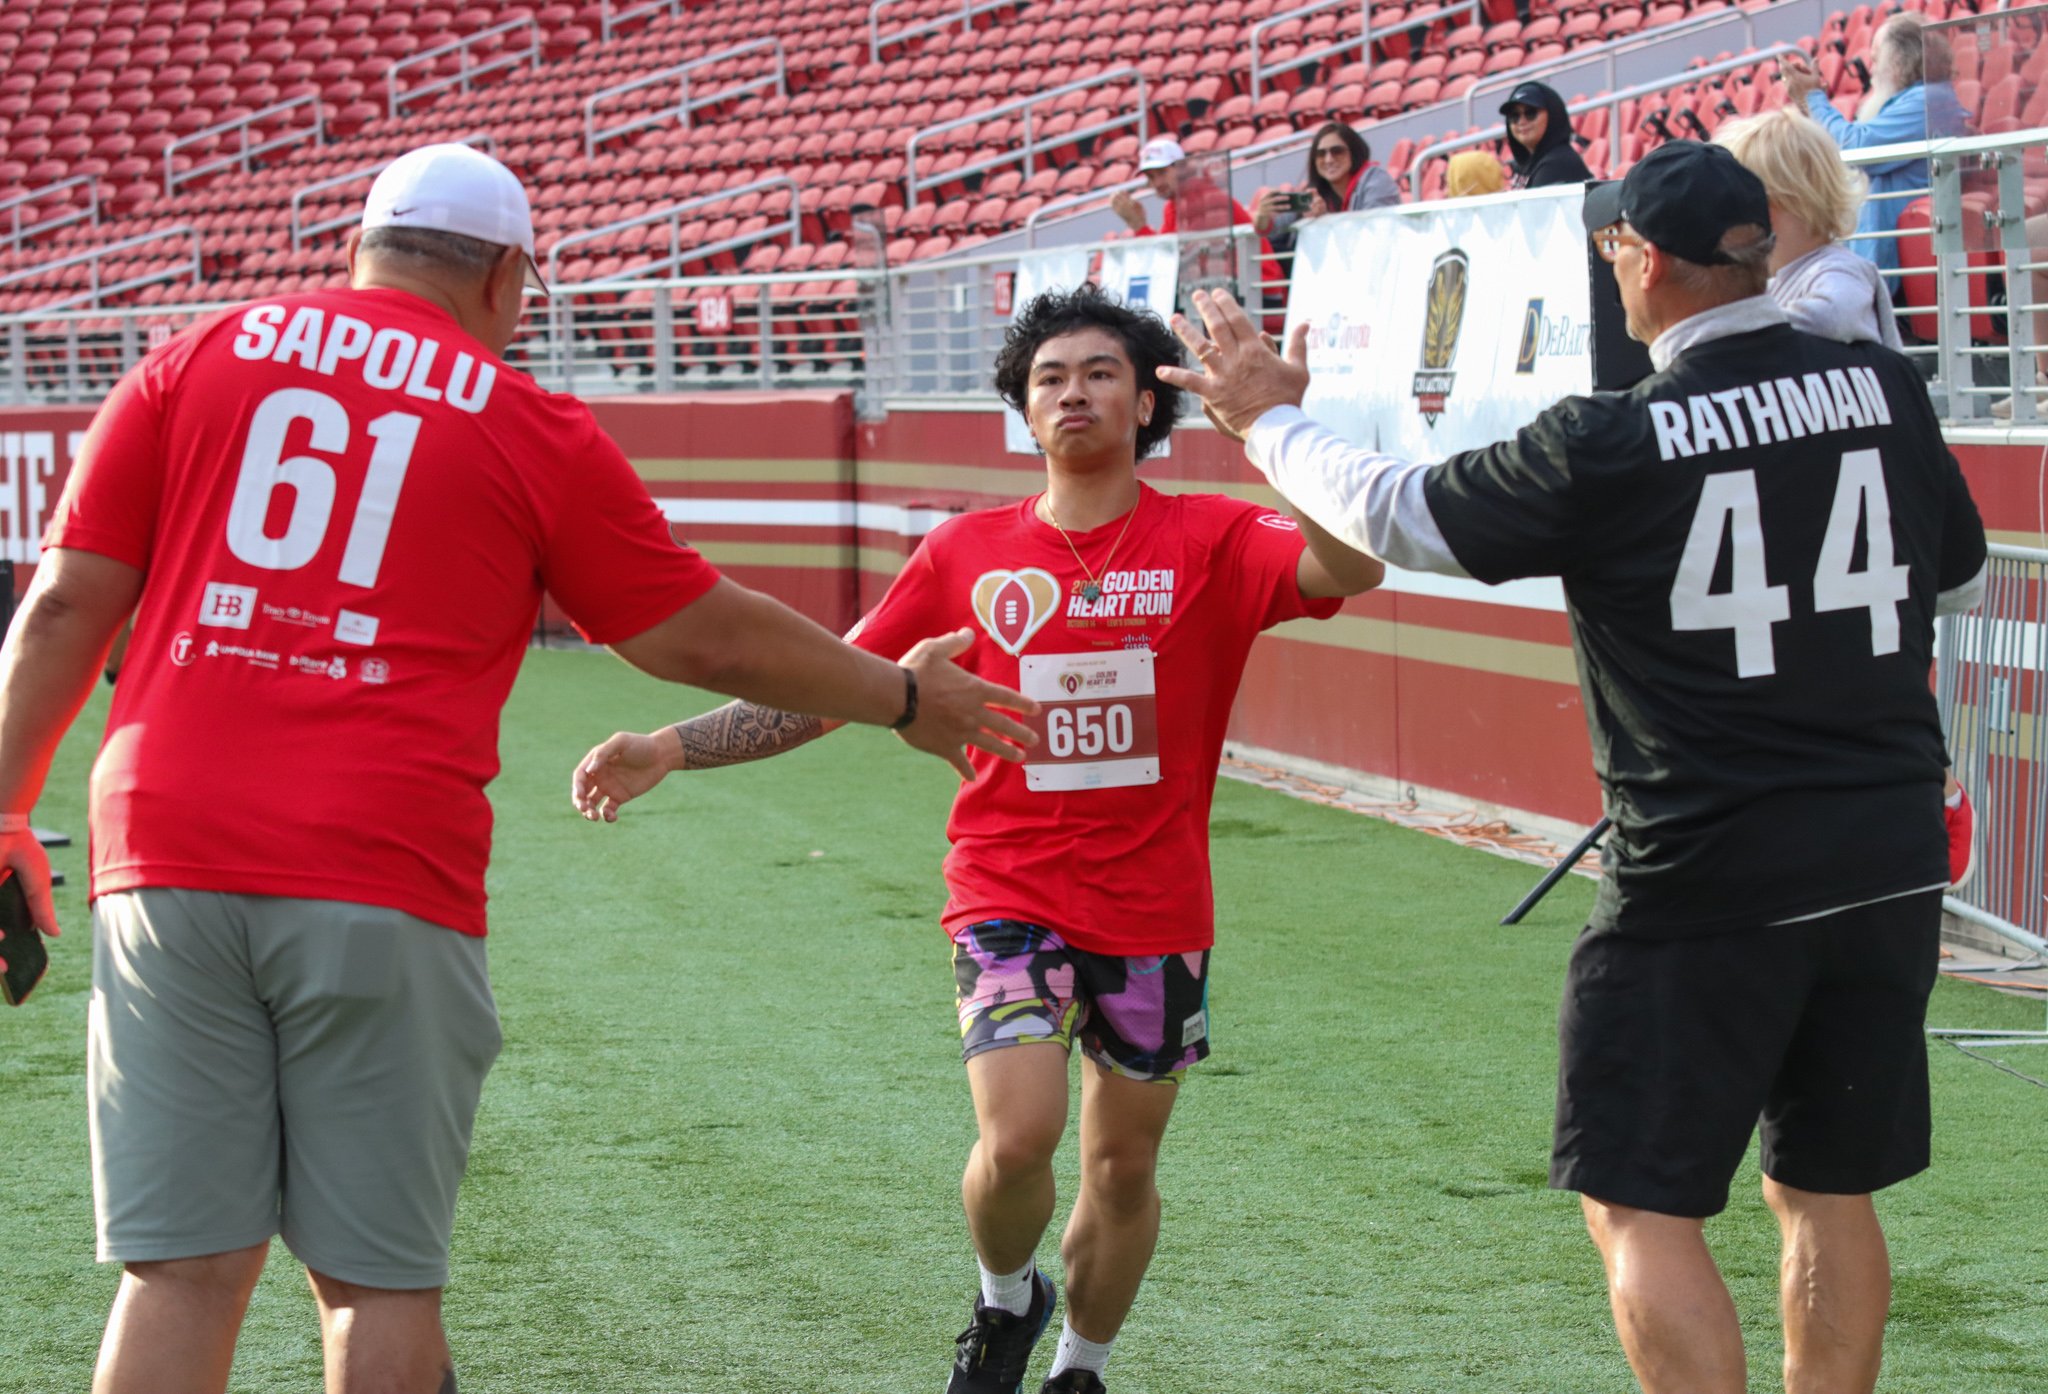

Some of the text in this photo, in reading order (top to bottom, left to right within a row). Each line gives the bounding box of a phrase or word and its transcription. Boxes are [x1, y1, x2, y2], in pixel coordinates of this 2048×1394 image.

[233, 304, 497, 414] SAPOLU
[1648, 366, 1892, 462] RATHMAN
[226, 387, 422, 588] 61
[1066, 592, 1173, 617] HEART RUN
[1102, 569, 1174, 593] GOLDEN
[1669, 447, 1911, 679] 44
[1047, 704, 1133, 757] 650
